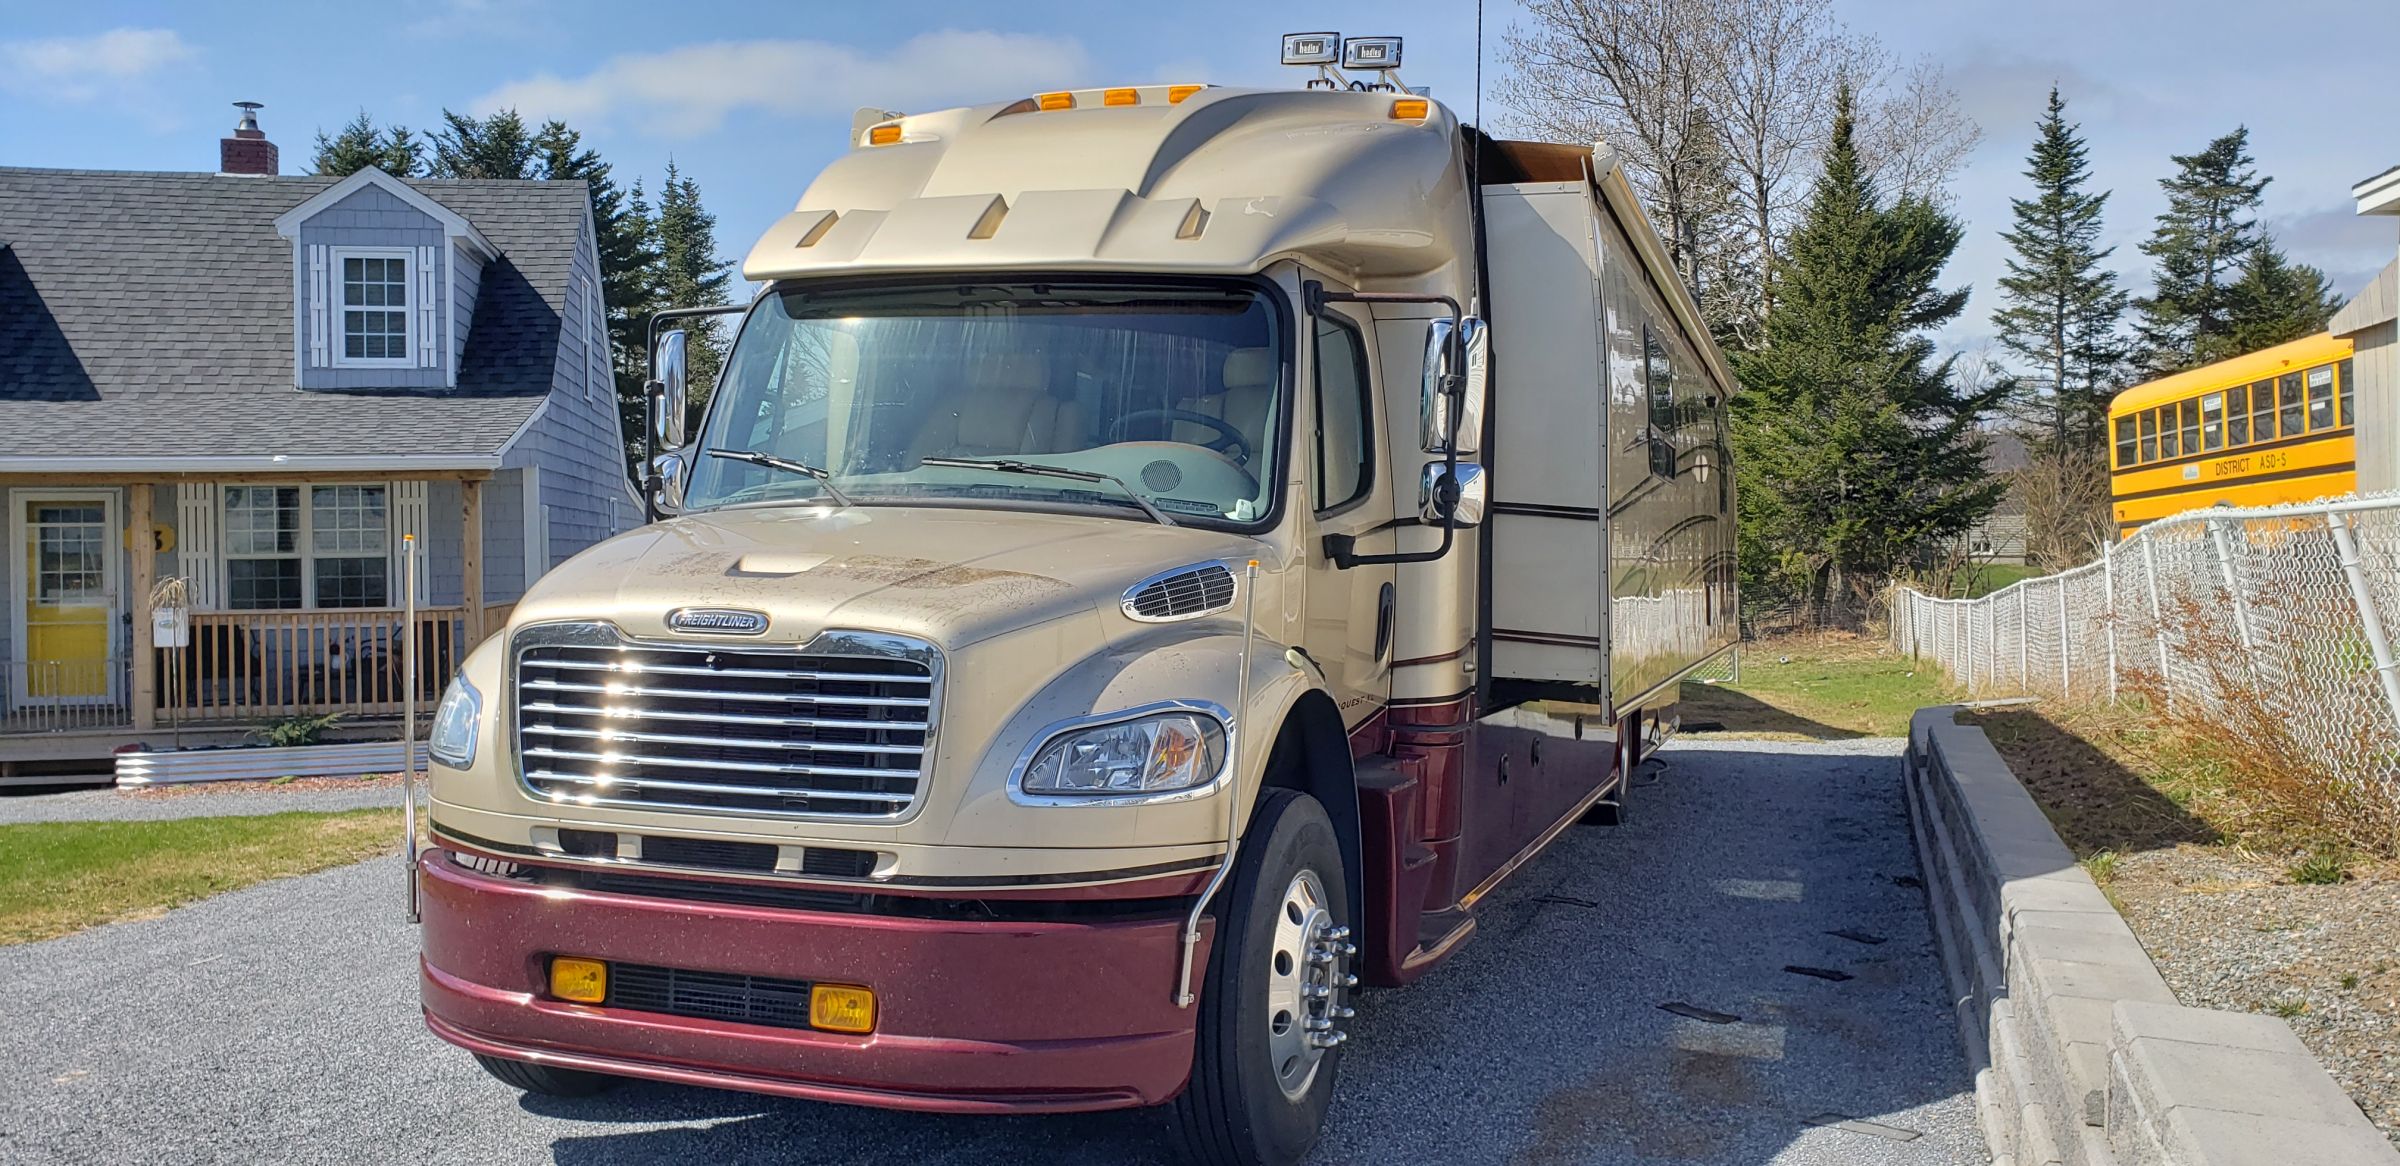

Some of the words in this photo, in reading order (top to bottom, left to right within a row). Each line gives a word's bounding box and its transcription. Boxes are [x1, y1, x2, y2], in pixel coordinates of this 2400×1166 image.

[1300, 41, 1319, 54] hadley
[1361, 46, 1381, 58] hadley
[2216, 458, 2250, 476] DISTRICT
[2260, 452, 2287, 469] ASD-S
[679, 614, 755, 628] FREIGHTLINER
